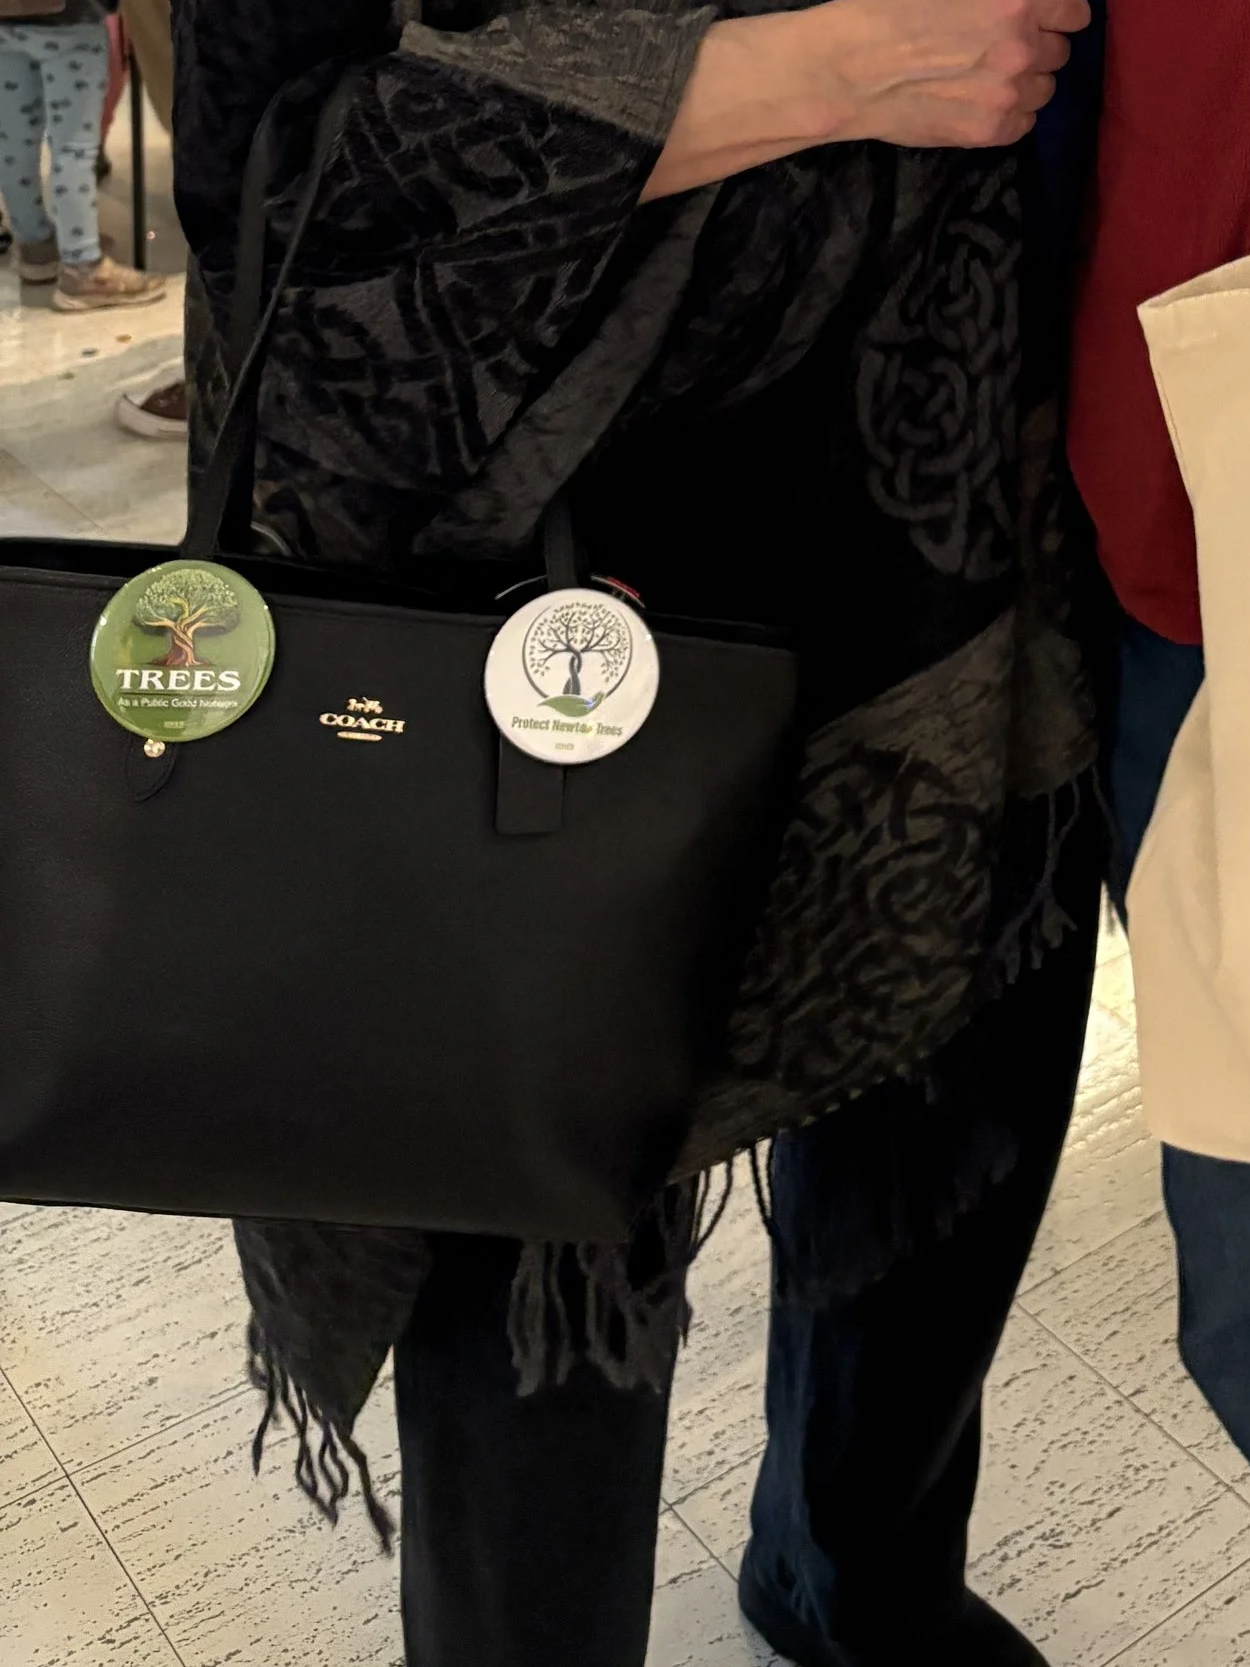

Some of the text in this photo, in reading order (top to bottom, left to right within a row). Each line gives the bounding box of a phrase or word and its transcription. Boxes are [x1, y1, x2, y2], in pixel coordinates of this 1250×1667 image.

[116, 668, 241, 691] TREES
[319, 713, 406, 734] COACH
[511, 716, 550, 731] Protect
[551, 719, 594, 734] Newto
